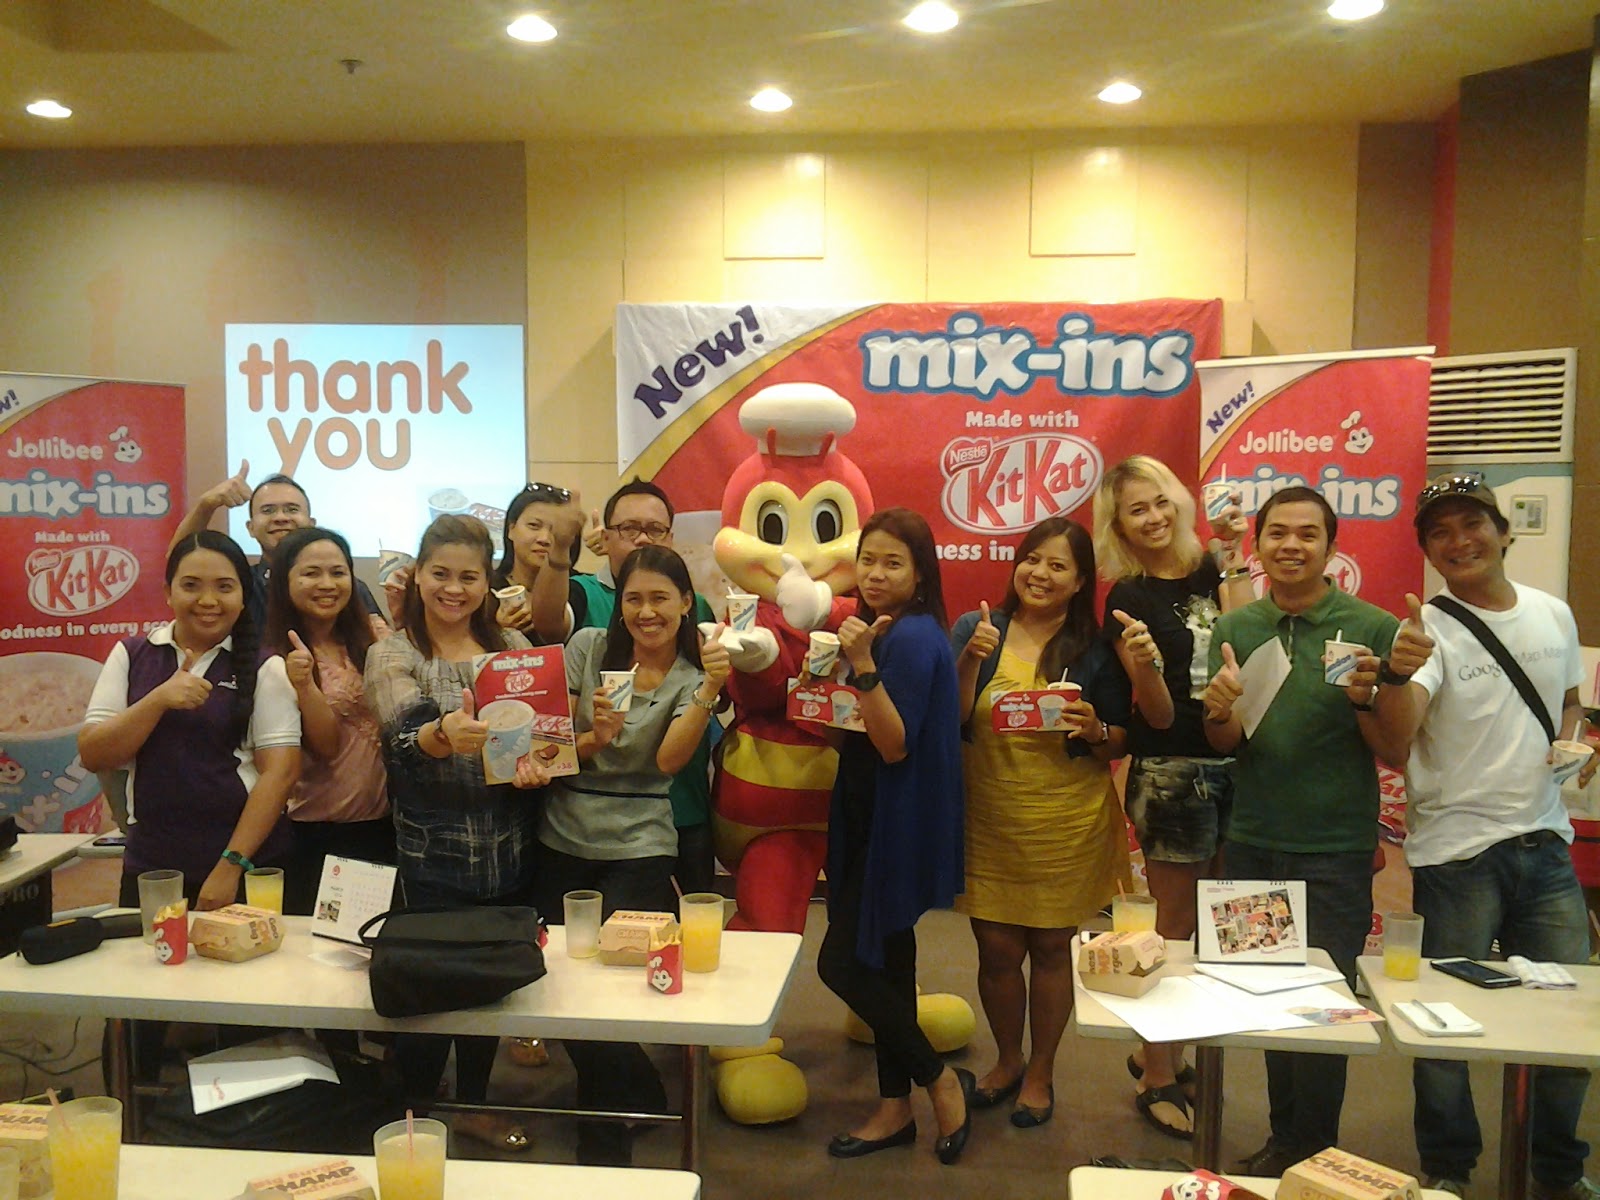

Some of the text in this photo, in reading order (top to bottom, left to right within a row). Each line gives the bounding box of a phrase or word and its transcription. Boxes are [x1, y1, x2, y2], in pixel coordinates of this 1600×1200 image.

[634, 304, 765, 420] New!
[862, 313, 1191, 398] mix-ins
[238, 337, 473, 414] thank
[965, 409, 1080, 429] Made with
[1205, 380, 1256, 434] New!
[7, 435, 104, 462] Jollibee
[266, 416, 412, 480] you
[1238, 428, 1335, 455] Jollibee
[966, 439, 1089, 528] KitKat
[34, 530, 111, 544] Made with
[988, 539, 1015, 561] in
[45, 549, 130, 611] KitKat
[66, 621, 85, 637] in
[89, 620, 139, 637] every
[1458, 661, 1502, 681] Goog
[267, 1166, 356, 1192] HAMP
[1308, 1155, 1400, 1190] CHAMP
